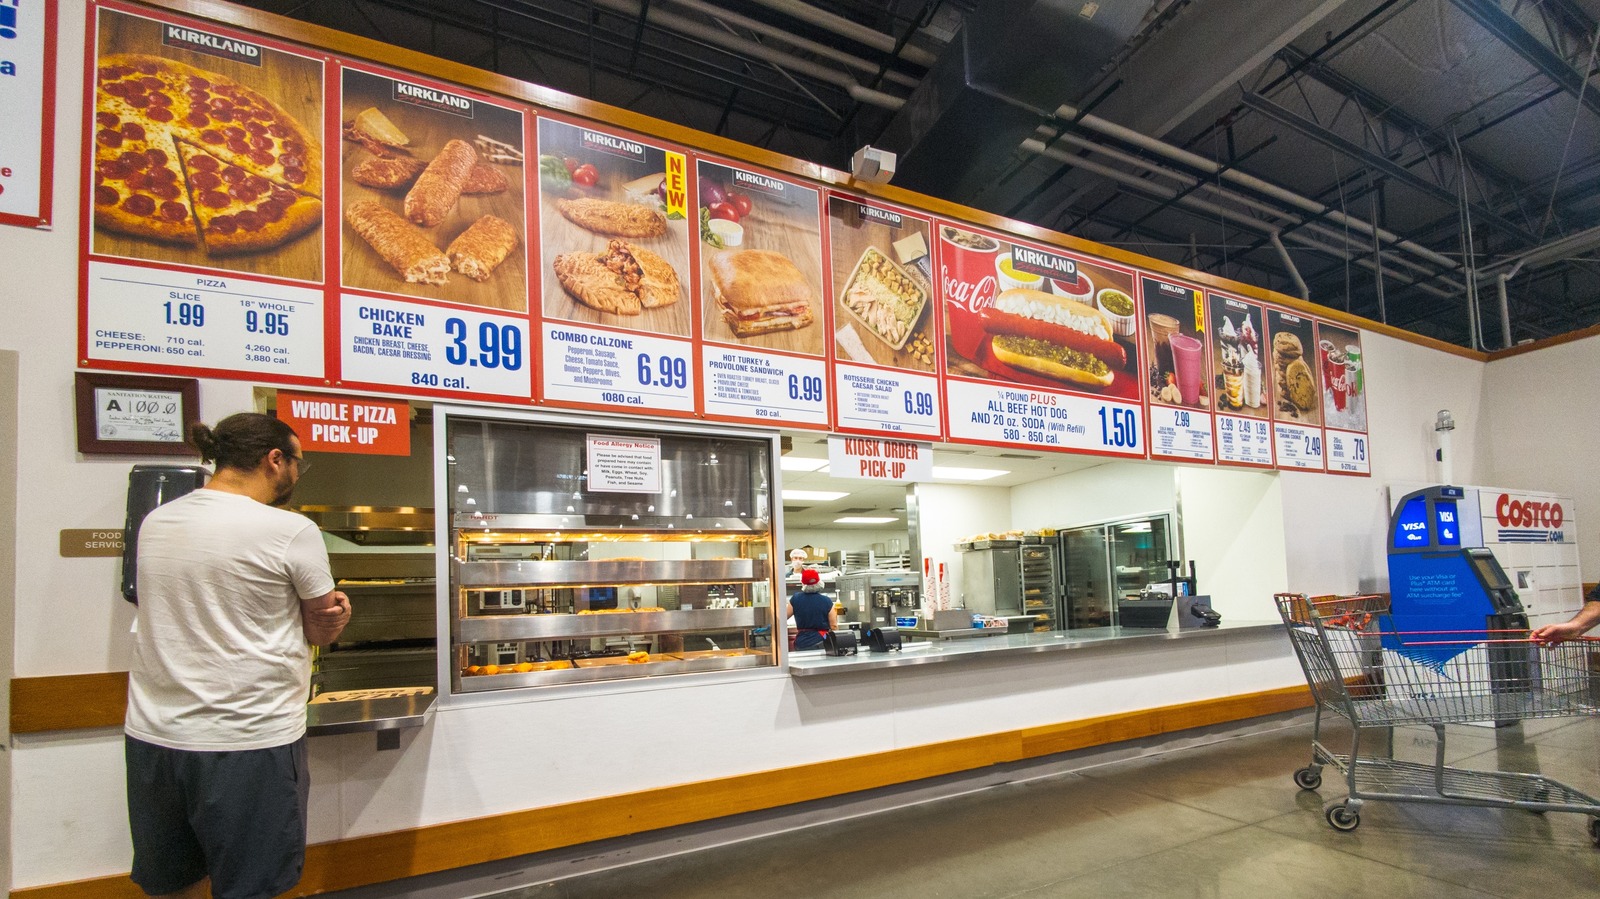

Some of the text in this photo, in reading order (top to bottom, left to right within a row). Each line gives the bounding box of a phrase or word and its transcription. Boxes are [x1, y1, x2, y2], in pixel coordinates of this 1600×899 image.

[168, 27, 258, 58] KIRKLAND
[398, 84, 470, 110] KIRKLAND
[584, 132, 643, 155] KIRKLAND
[669, 157, 684, 208] NEW
[736, 171, 784, 191] KIRKLAND
[860, 206, 900, 223] KIRKLAND
[1015, 248, 1075, 274] KIRKLAND
[197, 279, 227, 289] PIZZA
[1161, 283, 1185, 294] KIRKLAND
[169, 292, 200, 301] SLICE
[1226, 300, 1248, 309] KIRKLAND
[163, 301, 205, 327] 1.99
[240, 300, 295, 312] 18" WHOLE
[246, 310, 289, 336] 9.95
[359, 307, 424, 326] CHICKEN
[1281, 314, 1299, 323] KIRKLAND
[373, 323, 412, 339] BAKE
[551, 330, 633, 349] COMBO CALZONE
[96, 330, 289, 354] CHEESE: 710 cal. 4,260 cal.
[354, 336, 430, 352] CHICKEN BREAST, CHEESE,
[445, 318, 522, 371] 3.99
[96, 340, 289, 364] PEPPERONI: 650 cal. 3,880 cal.
[353, 345, 431, 361] BACON, CAESAR DRESSING
[739, 356, 763, 365] TURKEY
[638, 353, 686, 389] 6.99
[709, 361, 783, 376] PROVOLONE SANDWICH
[412, 372, 470, 389] 840 cal.
[789, 374, 822, 402] 6.99
[844, 374, 899, 387] ROTISSERIE CHICKEN
[852, 382, 873, 390] CAESAR
[106, 400, 122, 411] A
[602, 392, 644, 405] 1080 cal.
[904, 390, 933, 416] 6.99
[1006, 392, 1057, 405] POUND PLUS
[292, 401, 397, 424] WHOLE PIZZA
[988, 401, 1067, 419] ALL BEEF HOT DOG
[1175, 411, 1190, 427] 2.99
[971, 412, 990, 424] AND
[993, 414, 1003, 426] 20
[1007, 418, 1019, 427] oz.
[1022, 417, 1045, 429] SODA
[1048, 422, 1065, 433] (With
[1099, 406, 1136, 448] 1.50
[1221, 418, 1266, 435] 2.99 2.49 1.99
[312, 424, 378, 444] PICK-UP
[1004, 429, 1060, 444] 580 850 cal.
[845, 438, 918, 460] KIOSK ORDER
[1305, 436, 1320, 455] 2.49
[1353, 438, 1364, 460] .79
[860, 460, 905, 478] PICK-UP
[1439, 512, 1454, 522] VISA
[1496, 494, 1563, 528] COSTCO
[1401, 522, 1426, 530] VISA
